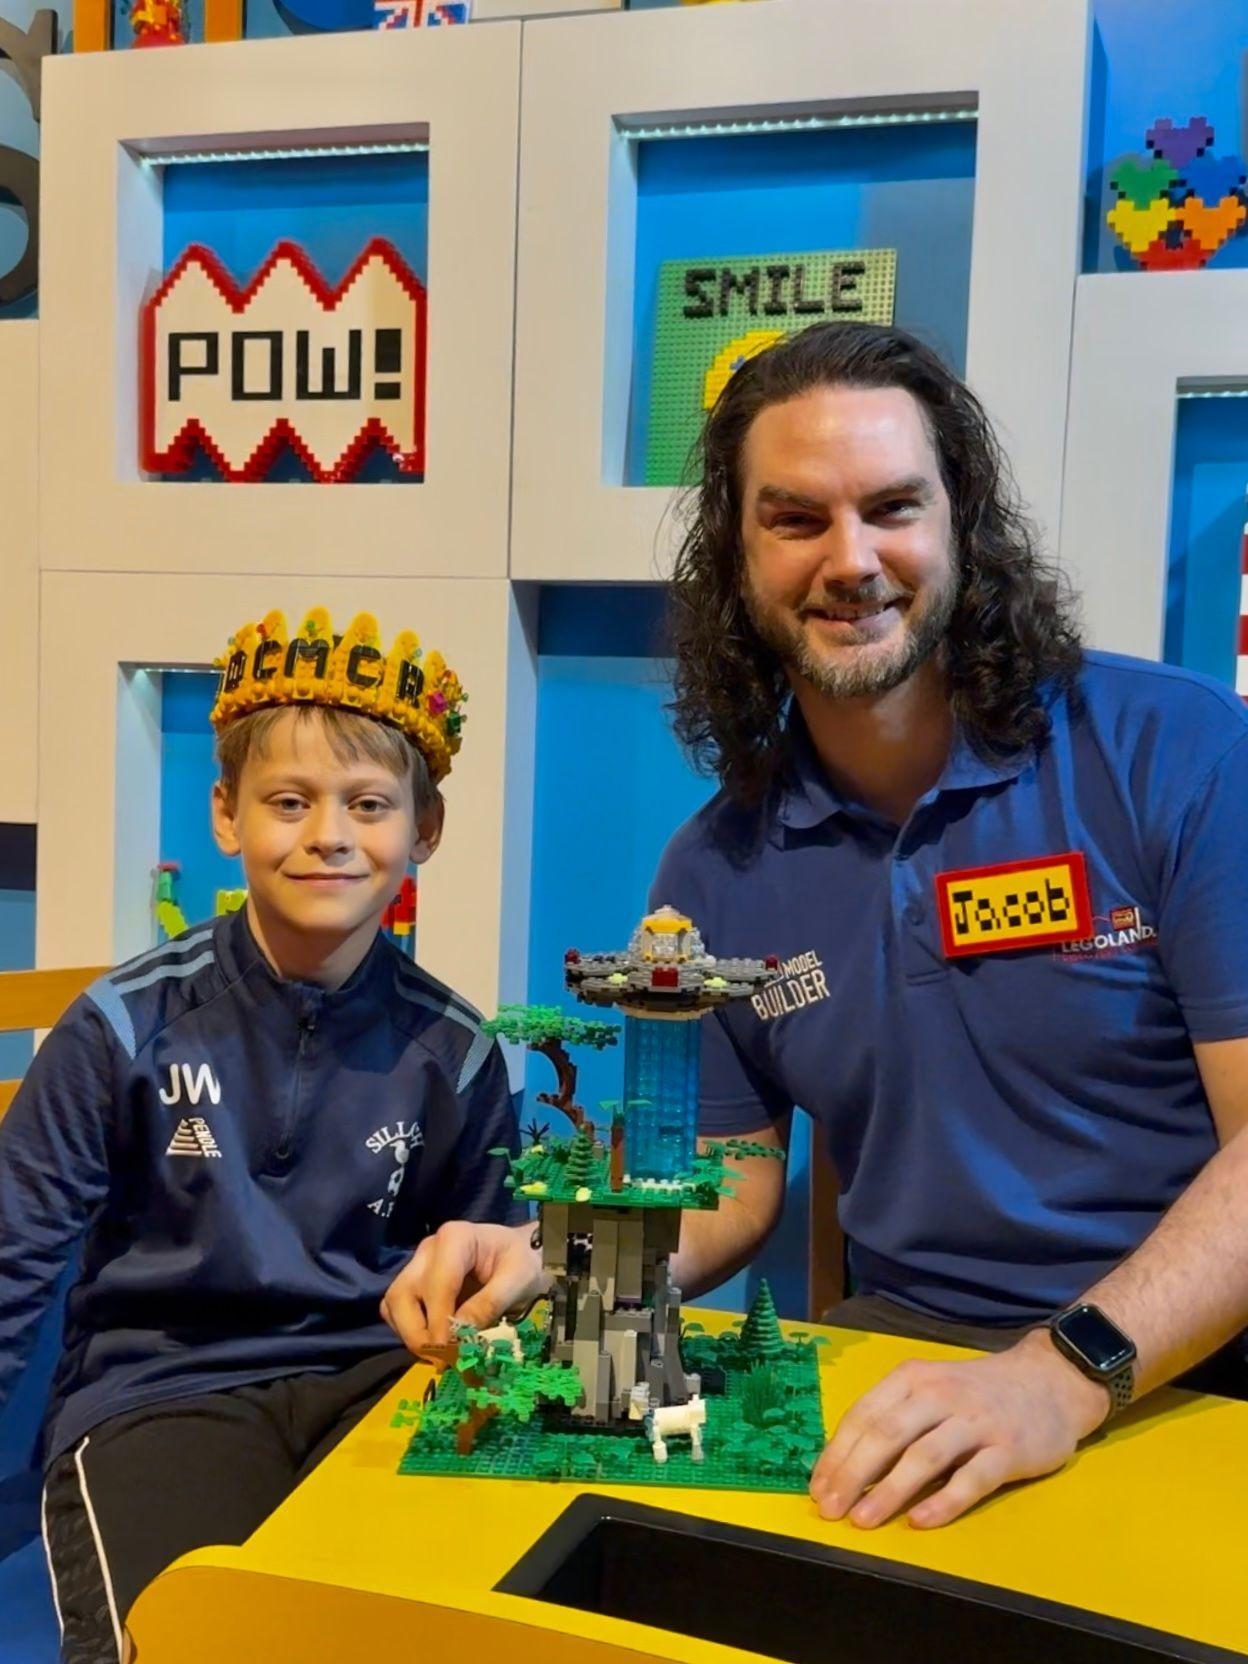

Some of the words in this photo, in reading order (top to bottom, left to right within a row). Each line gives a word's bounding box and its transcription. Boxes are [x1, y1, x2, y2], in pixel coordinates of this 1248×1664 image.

[683, 261, 865, 317] SMILE
[168, 329, 402, 401] POW!
[952, 878, 1070, 934] Jacob
[782, 950, 823, 979] MODEL
[751, 969, 830, 1020] BUILDER
[159, 1063, 221, 1105] JW
